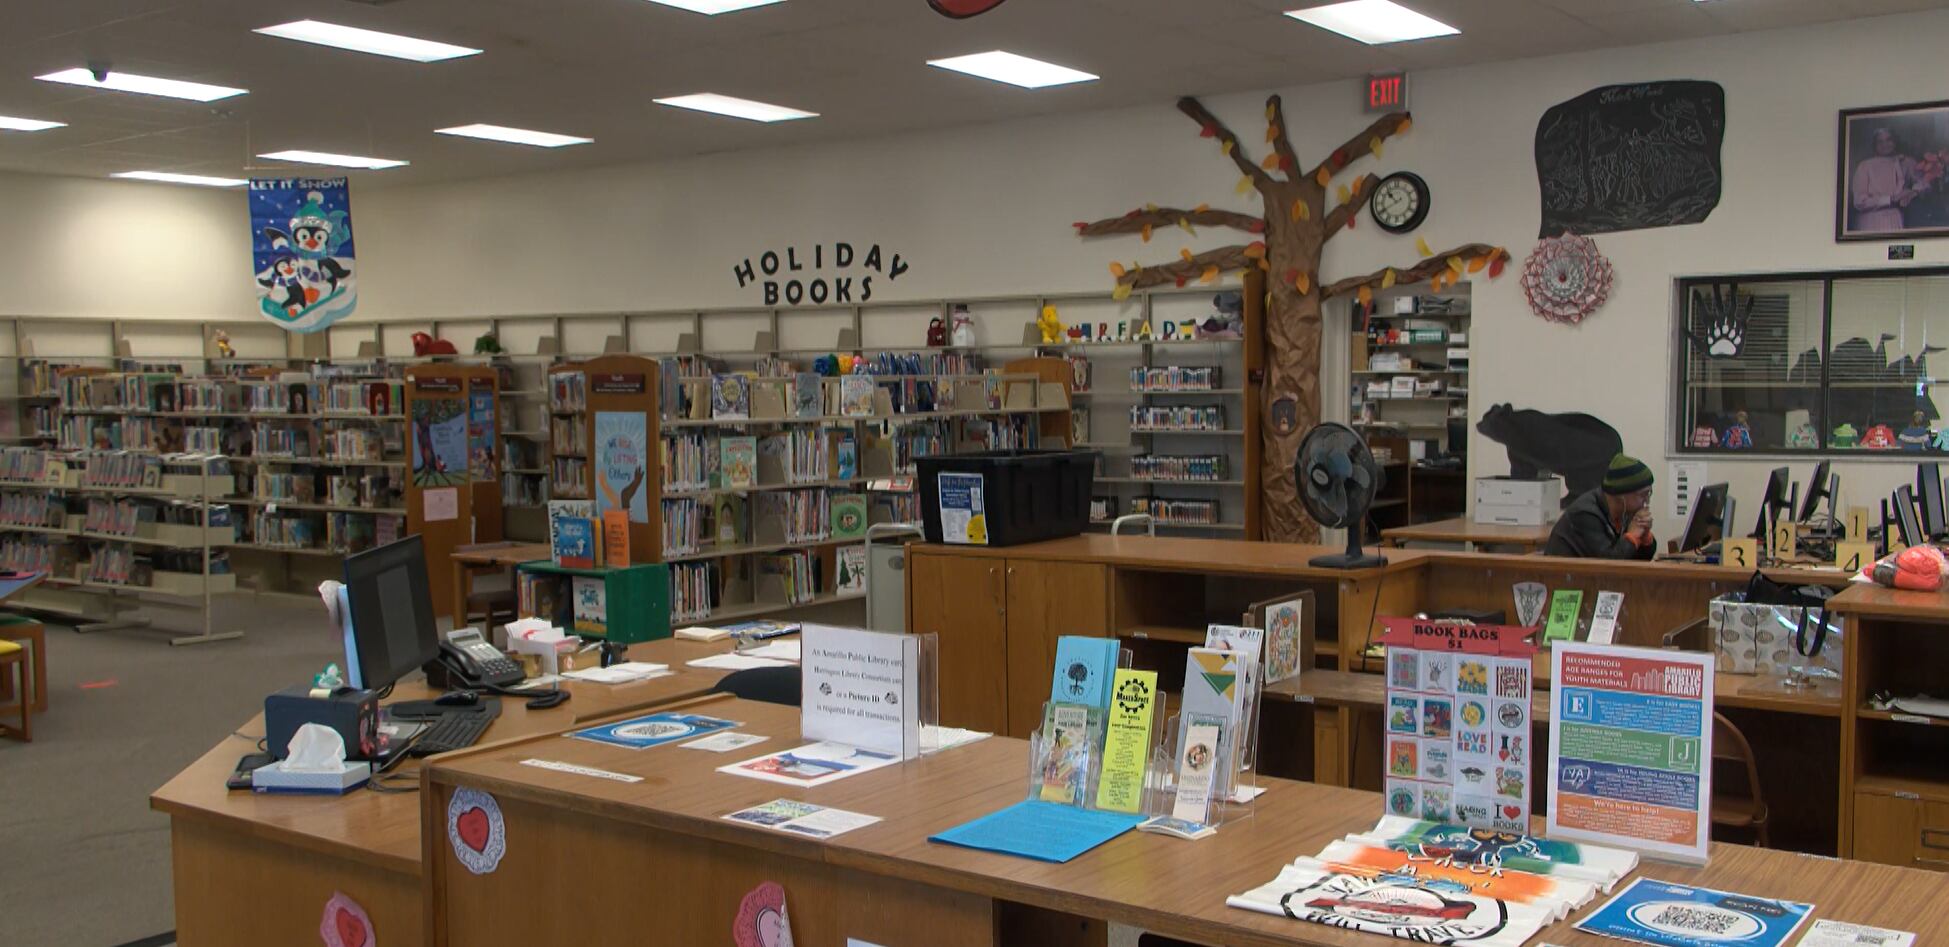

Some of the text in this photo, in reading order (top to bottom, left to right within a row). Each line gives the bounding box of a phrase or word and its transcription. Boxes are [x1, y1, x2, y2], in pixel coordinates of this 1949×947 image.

[1370, 77, 1401, 107] EXIT
[250, 178, 345, 190] LET IT SNOW
[733, 242, 909, 289] HOLIDAY
[764, 276, 872, 306] BOOKS
[1853, 514, 1859, 537] 1
[1779, 528, 1789, 552] 2
[1730, 546, 1745, 567] 3
[1843, 552, 1860, 573] 4
[1414, 624, 1498, 641] BOOK BAGS
[822, 649, 847, 659] Amarillo
[847, 651, 866, 662] Public
[867, 655, 889, 667] Library
[1565, 656, 1621, 668] RECOMMENDED
[841, 670, 860, 680] Library
[1565, 666, 1624, 678] AGE RANGES FOR
[1665, 666, 1702, 678] AMARILLO
[1565, 674, 1628, 689] YOUTH MATERIALS
[1665, 673, 1702, 688] PUBLIC
[848, 691, 870, 702] Picture
[1665, 684, 1701, 697] LIBRARY
[822, 705, 846, 716] required
[847, 707, 855, 715] for
[856, 709, 864, 717] all
[1571, 697, 1584, 713] E
[1457, 731, 1487, 744] LOVE
[1457, 742, 1487, 754] READ
[1678, 742, 1690, 760] J
[1494, 802, 1502, 819] I
[1593, 799, 1614, 809] We're
[1615, 802, 1631, 810] here
[1641, 805, 1660, 815] help!
